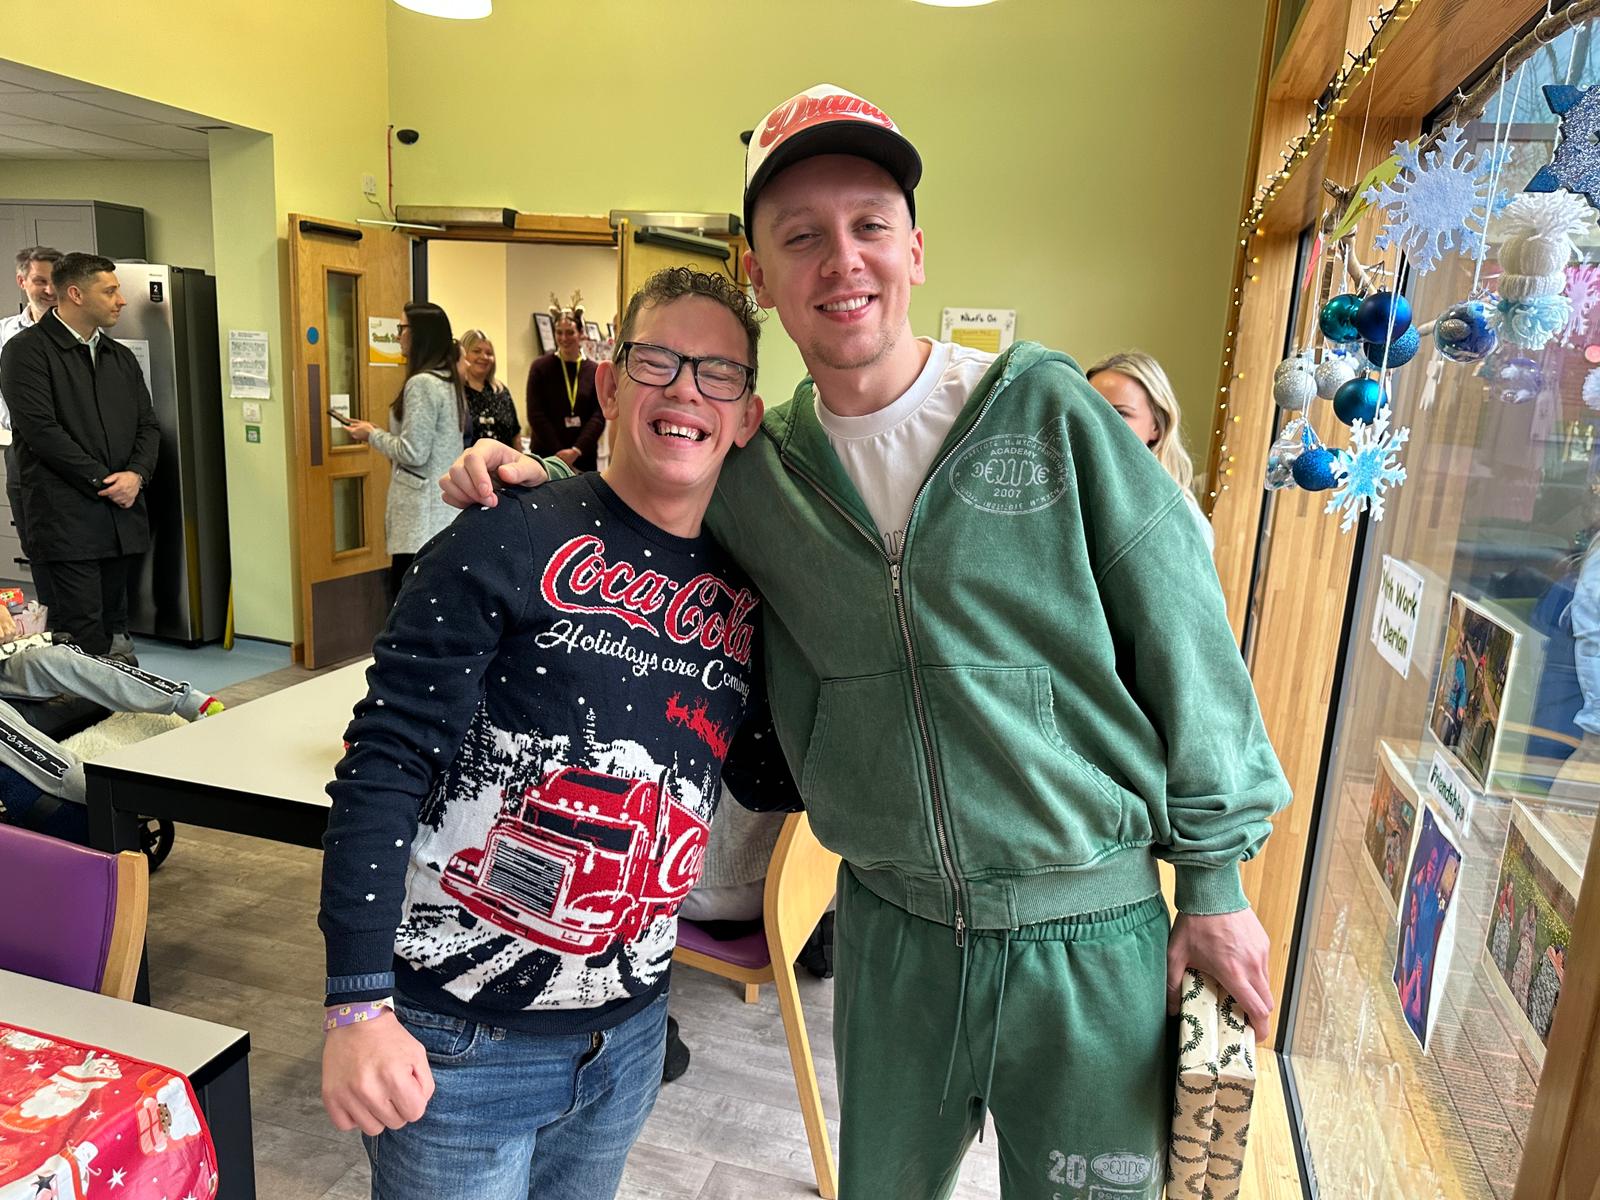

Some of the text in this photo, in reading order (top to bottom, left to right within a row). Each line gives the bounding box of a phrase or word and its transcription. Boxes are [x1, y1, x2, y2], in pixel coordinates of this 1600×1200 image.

[990, 447, 1038, 460] ACADEMY
[993, 488, 1022, 499] 2007
[541, 534, 760, 666] Coca-Cola
[1395, 581, 1418, 620] Work
[535, 619, 750, 706] Holidays are Coming
